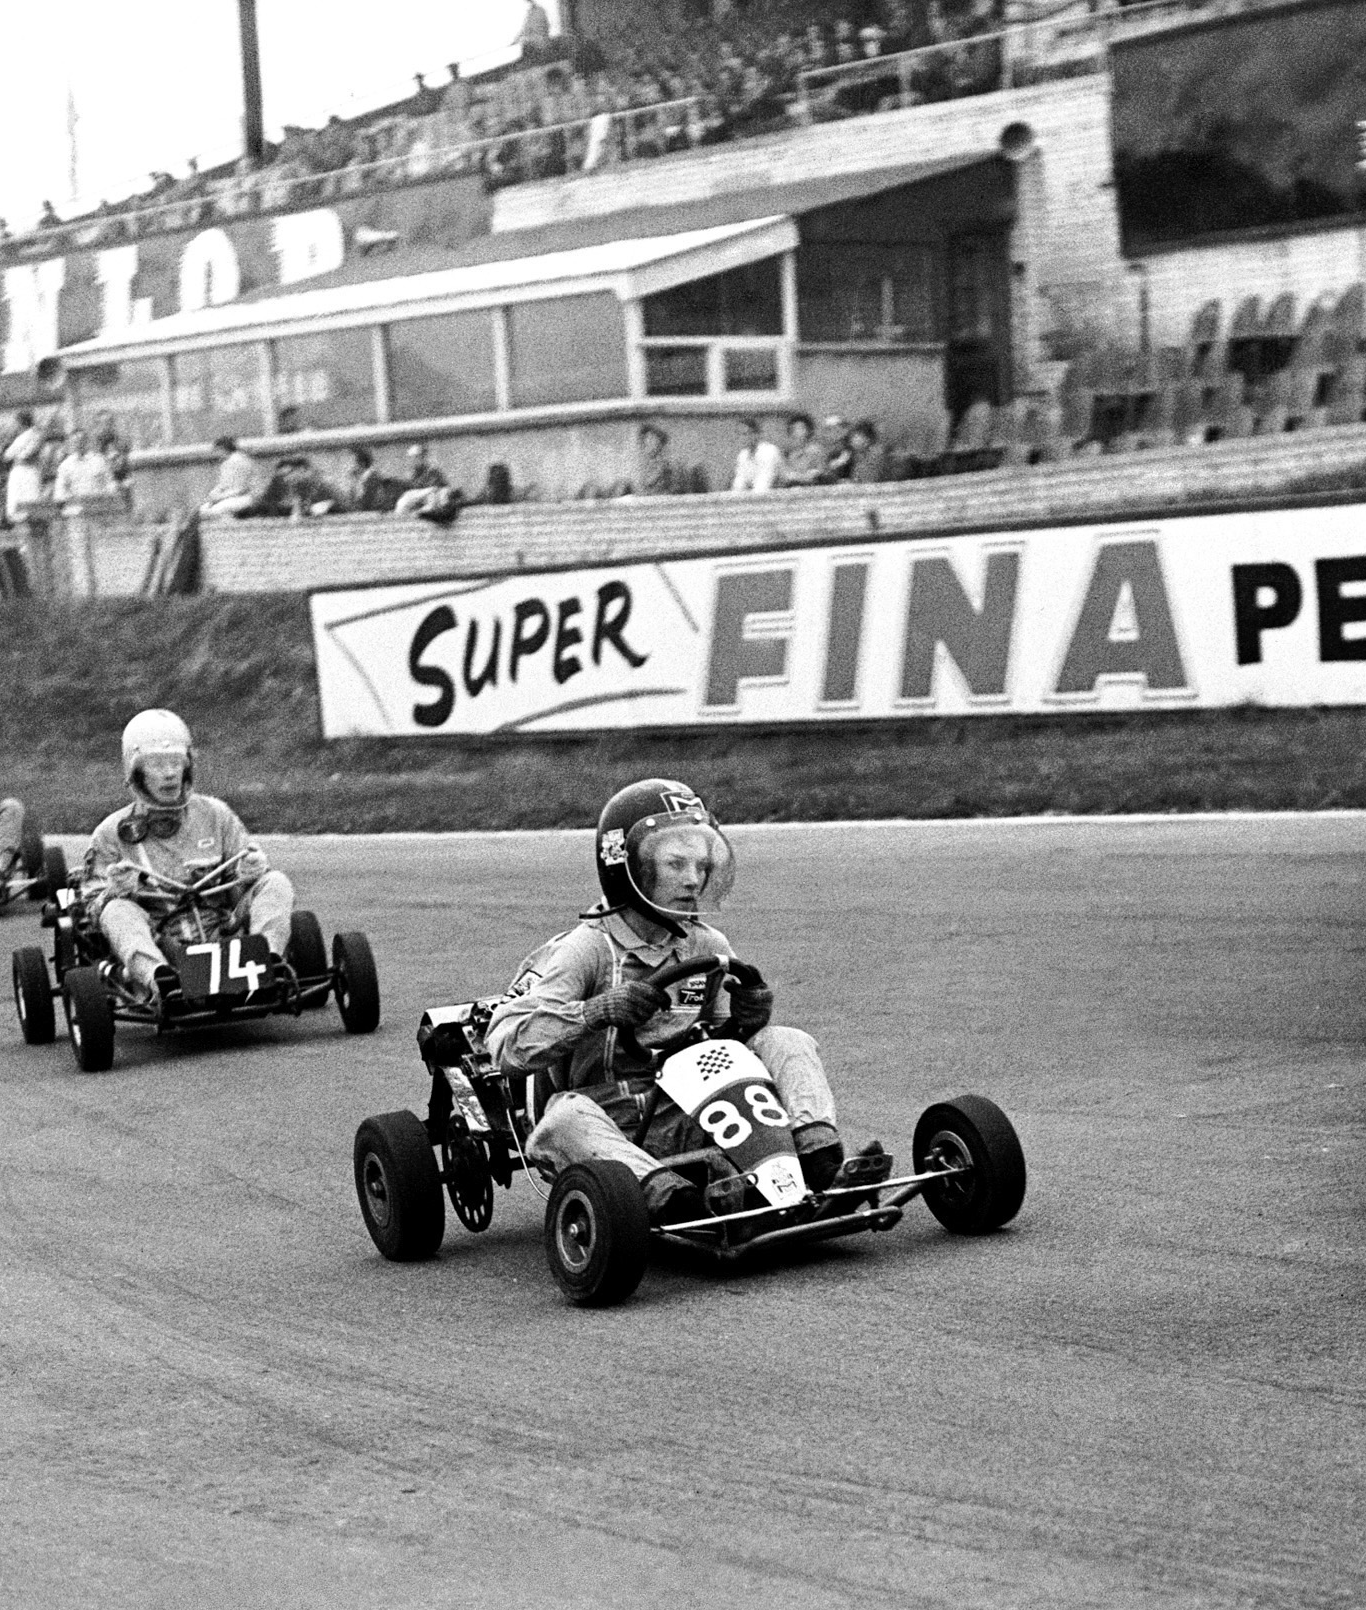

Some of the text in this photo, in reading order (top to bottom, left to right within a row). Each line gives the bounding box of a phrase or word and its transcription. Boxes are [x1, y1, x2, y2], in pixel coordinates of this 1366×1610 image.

[407, 580, 650, 727] SUPER
[699, 528, 1198, 717] FINA
[186, 938, 267, 995] 74
[698, 1084, 792, 1150] 88
